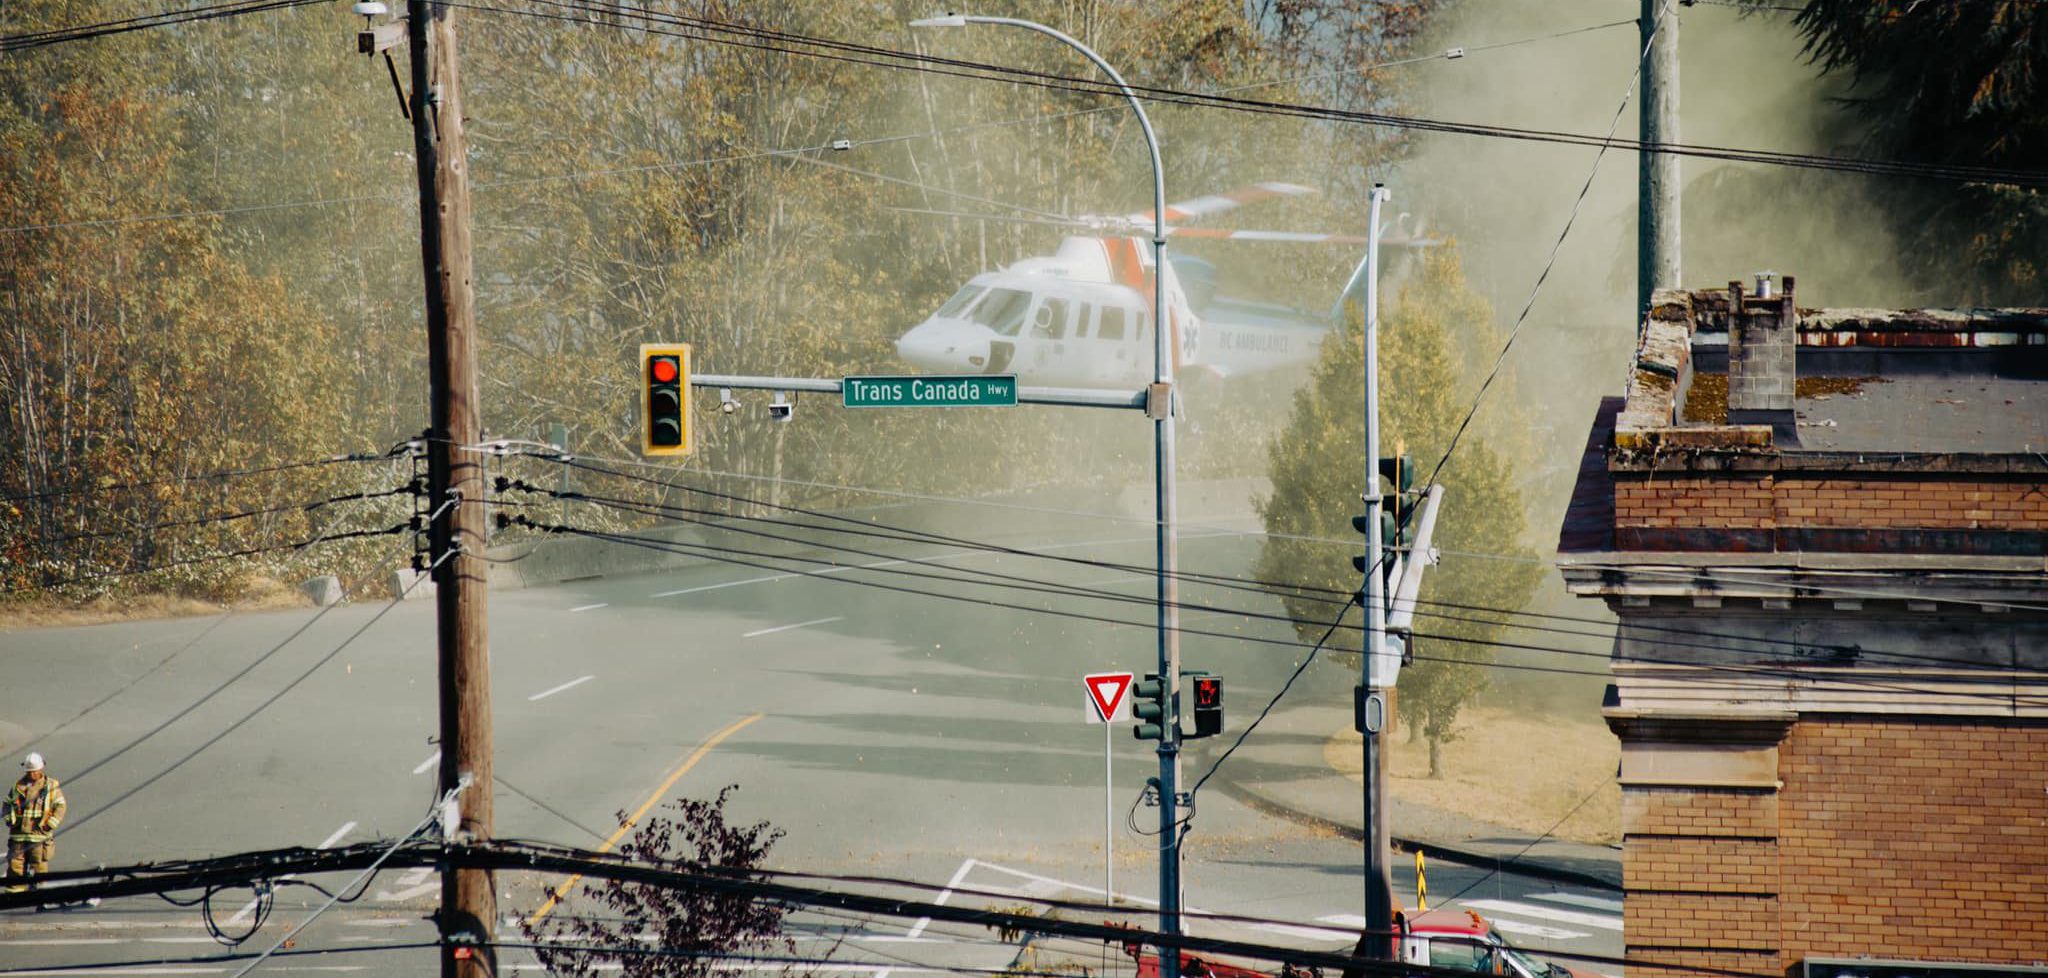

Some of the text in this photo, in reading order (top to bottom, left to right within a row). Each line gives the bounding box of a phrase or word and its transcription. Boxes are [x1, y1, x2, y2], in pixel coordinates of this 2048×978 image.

[851, 379, 1008, 400] Trans Canada Hwy
